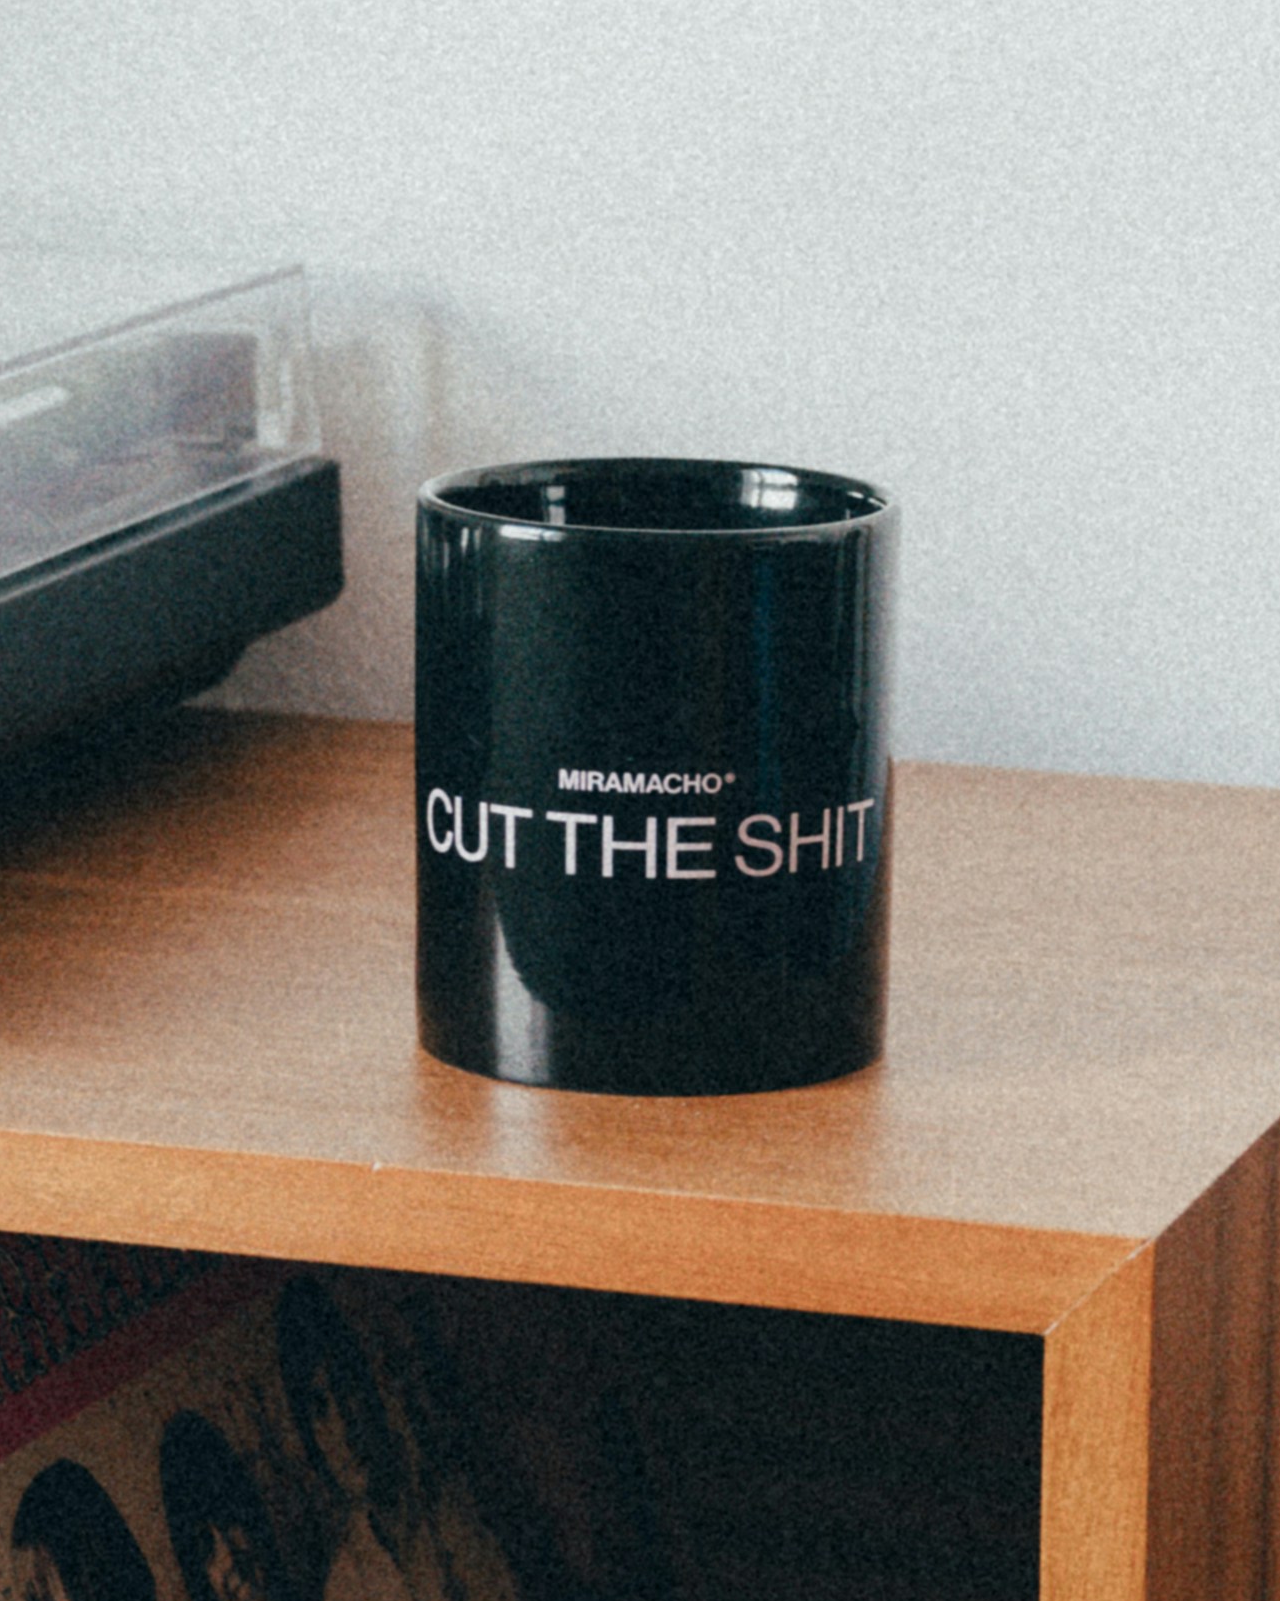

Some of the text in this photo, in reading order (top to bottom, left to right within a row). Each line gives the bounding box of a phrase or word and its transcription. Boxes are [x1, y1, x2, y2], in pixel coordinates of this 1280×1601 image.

[426, 787, 875, 879] CUT THE SHIT
